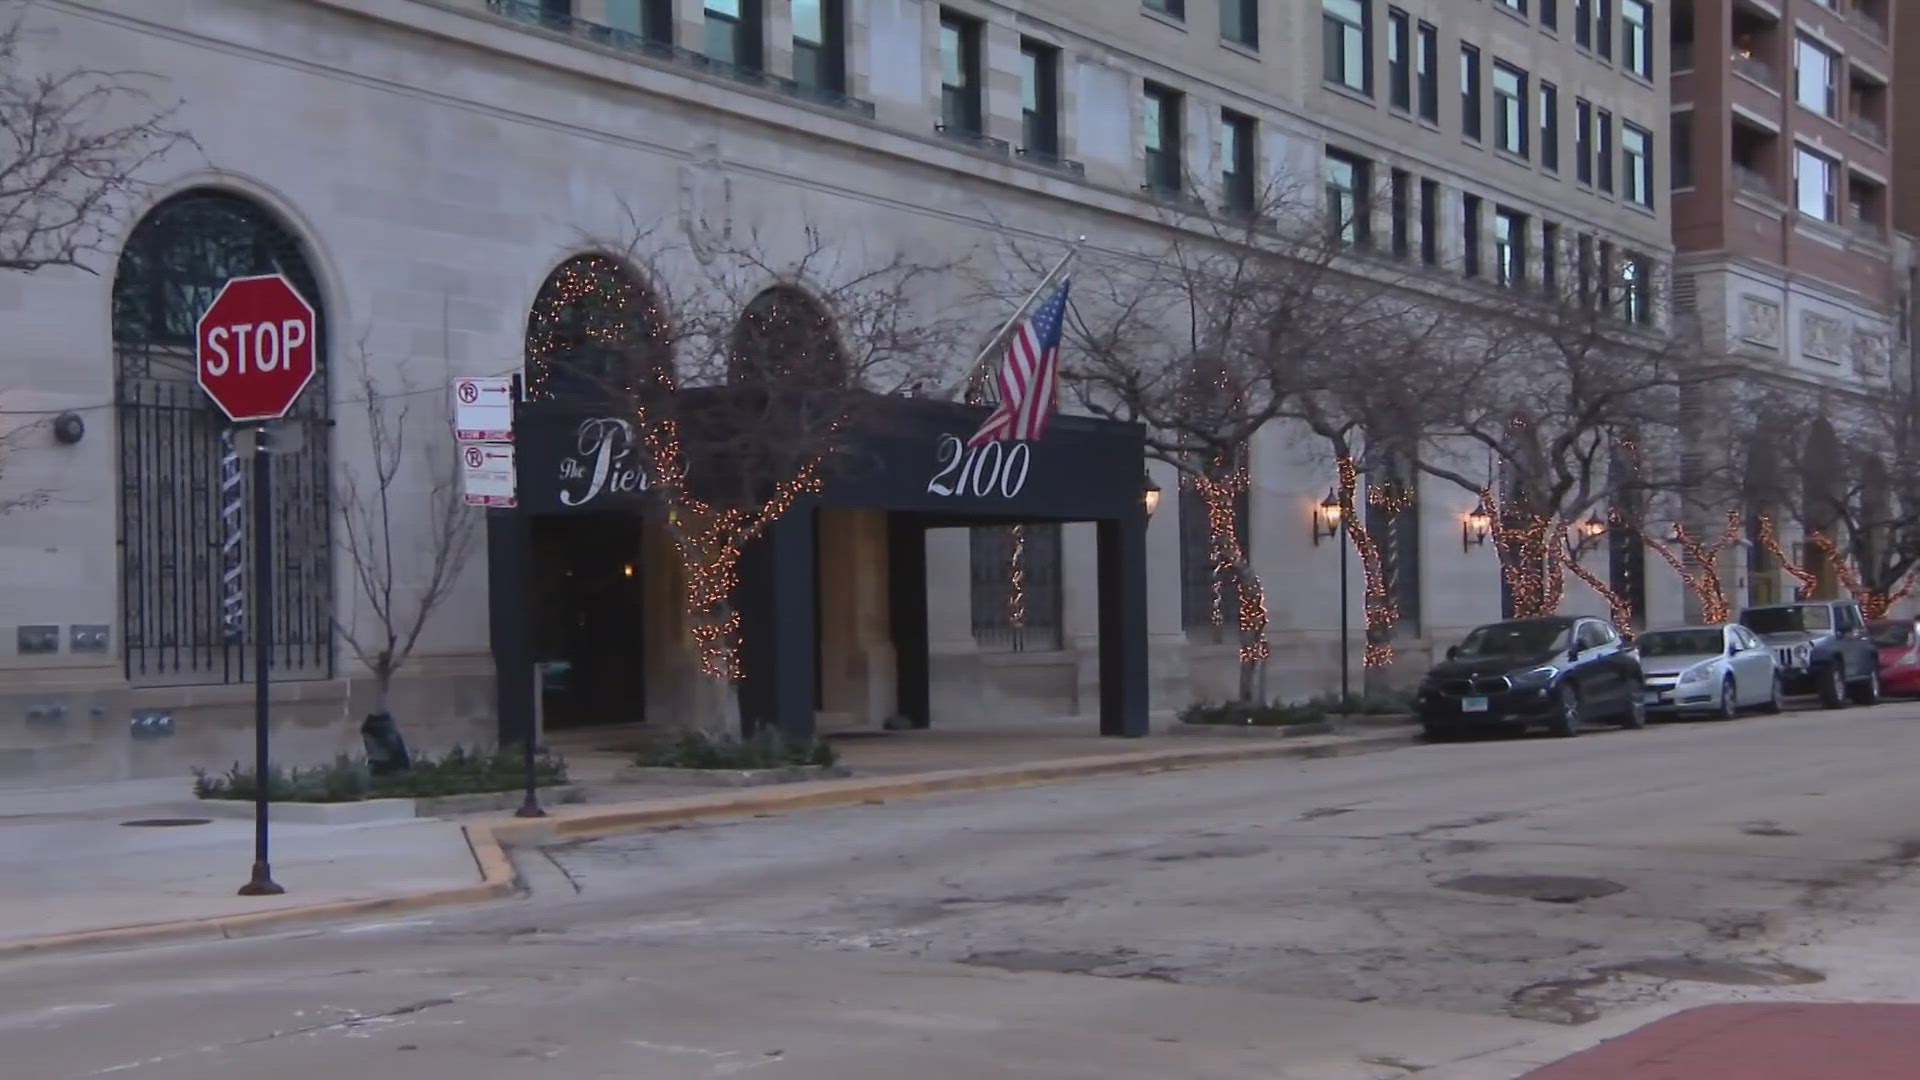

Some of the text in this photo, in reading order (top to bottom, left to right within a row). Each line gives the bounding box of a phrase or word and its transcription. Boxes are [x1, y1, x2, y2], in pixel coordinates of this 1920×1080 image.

[206, 319, 306, 377] STOP
[559, 417, 690, 506] The Pier
[928, 433, 1030, 498] 2100
